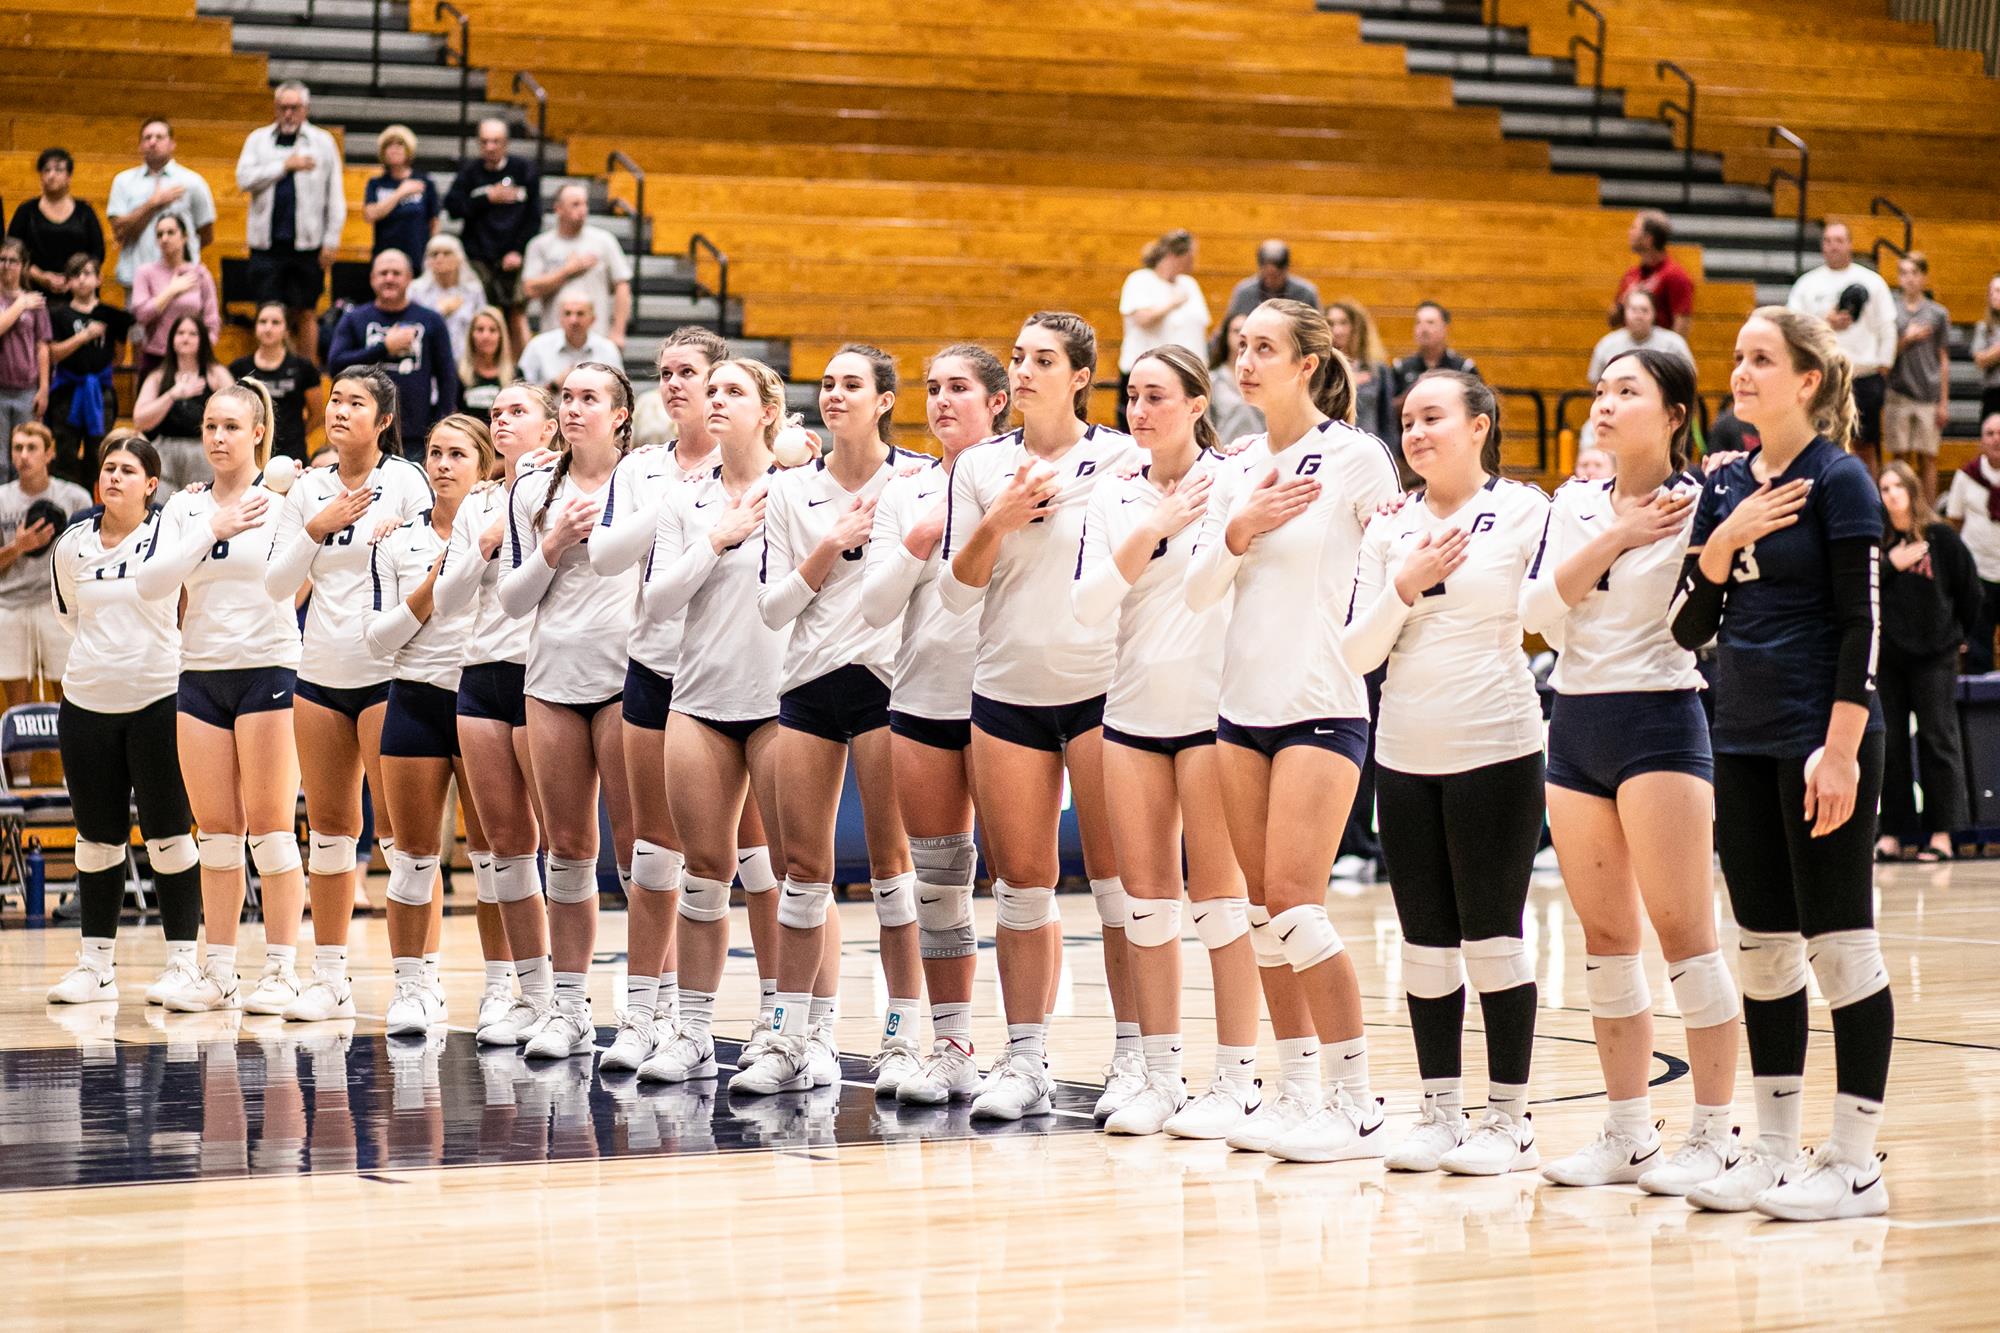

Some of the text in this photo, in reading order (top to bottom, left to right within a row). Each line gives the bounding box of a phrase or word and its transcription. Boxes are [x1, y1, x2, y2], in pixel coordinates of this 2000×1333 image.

[1296, 454, 1322, 475] G
[1471, 513, 1496, 534] G
[1733, 543, 1760, 583] 3
[13, 714, 59, 736] BRUI
